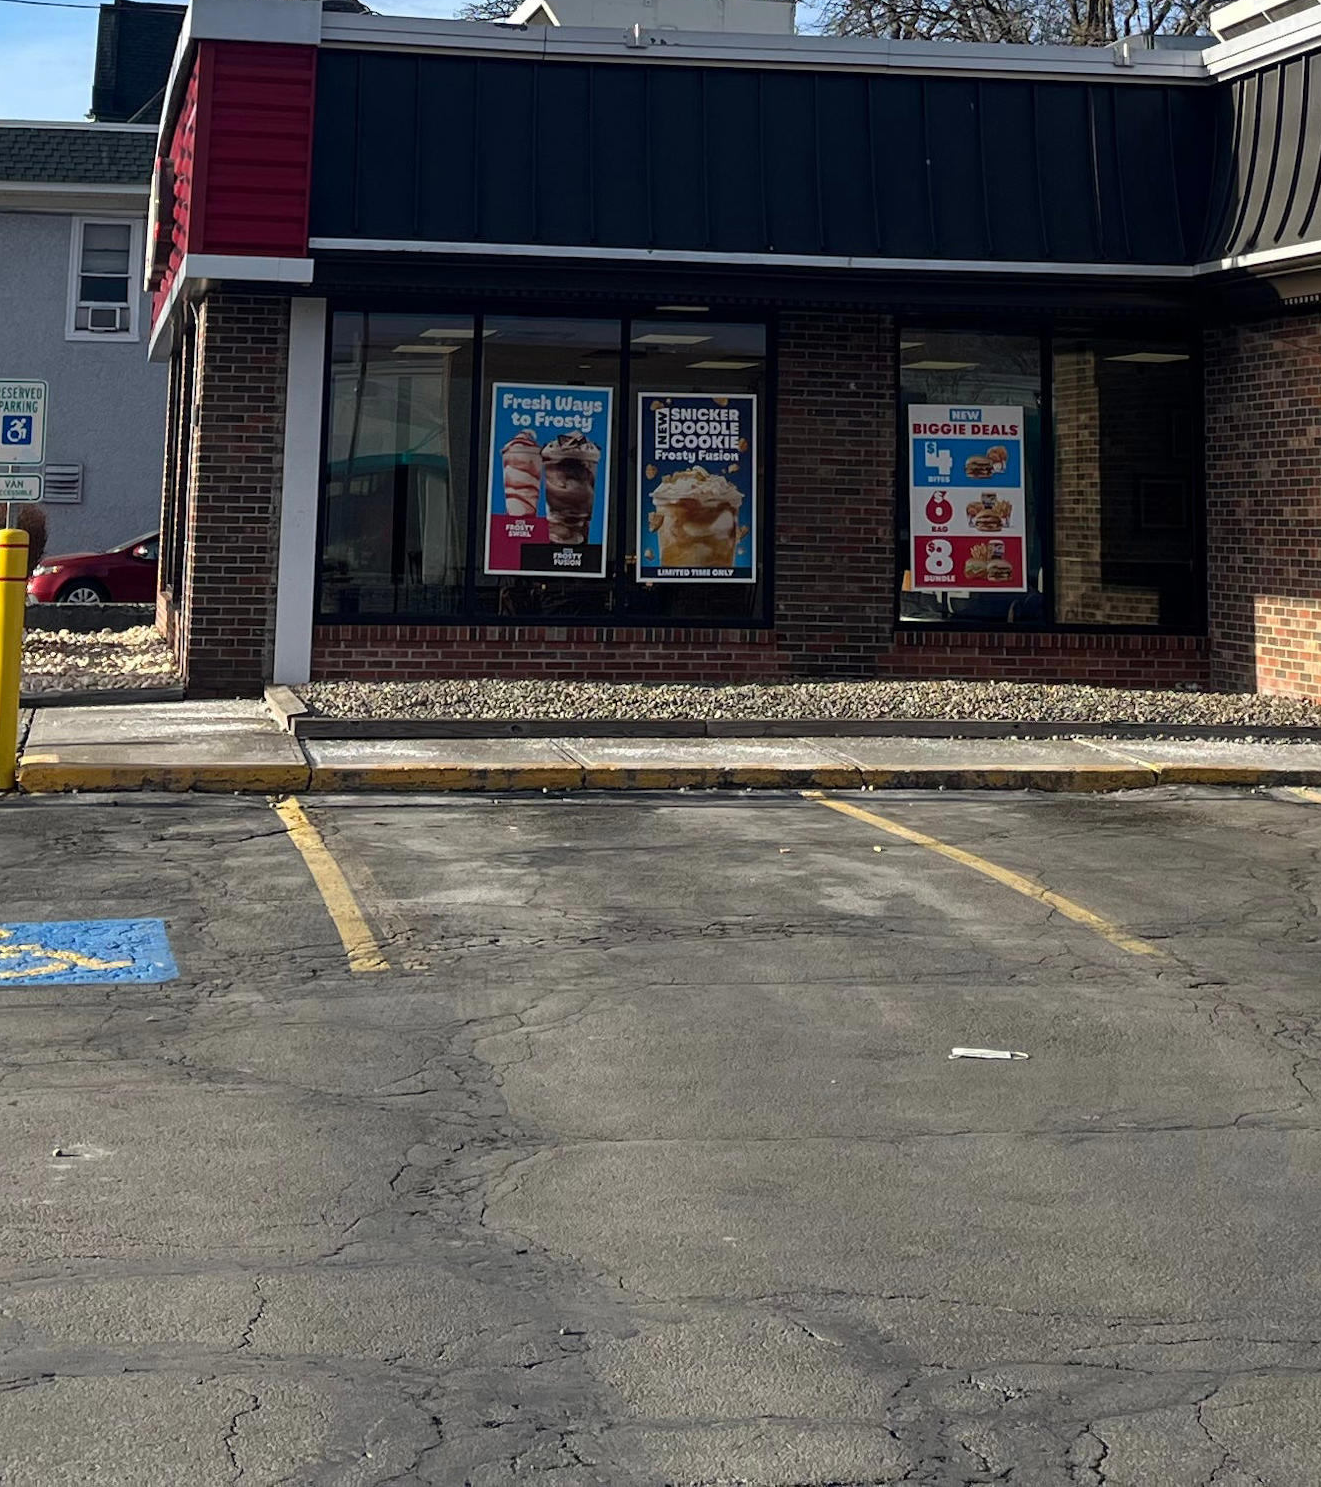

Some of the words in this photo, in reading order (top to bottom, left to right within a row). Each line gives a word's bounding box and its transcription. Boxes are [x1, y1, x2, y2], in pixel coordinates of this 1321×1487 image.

[503, 393, 551, 410] Fresh
[555, 395, 603, 416] Ways
[670, 408, 739, 421] SNICKER
[951, 410, 979, 420] NEW
[511, 412, 531, 426] to
[534, 411, 593, 433] Frosty
[657, 411, 667, 444] NEW
[670, 421, 739, 435] DOODLE
[912, 423, 966, 435] BIGGIE
[971, 424, 1018, 436] DEALS
[670, 434, 739, 449] COOKIE
[655, 449, 696, 463] Frosty
[698, 449, 739, 461] Fusion
[4, 480, 24, 489] VAN
[553, 552, 583, 560] FROSTY
